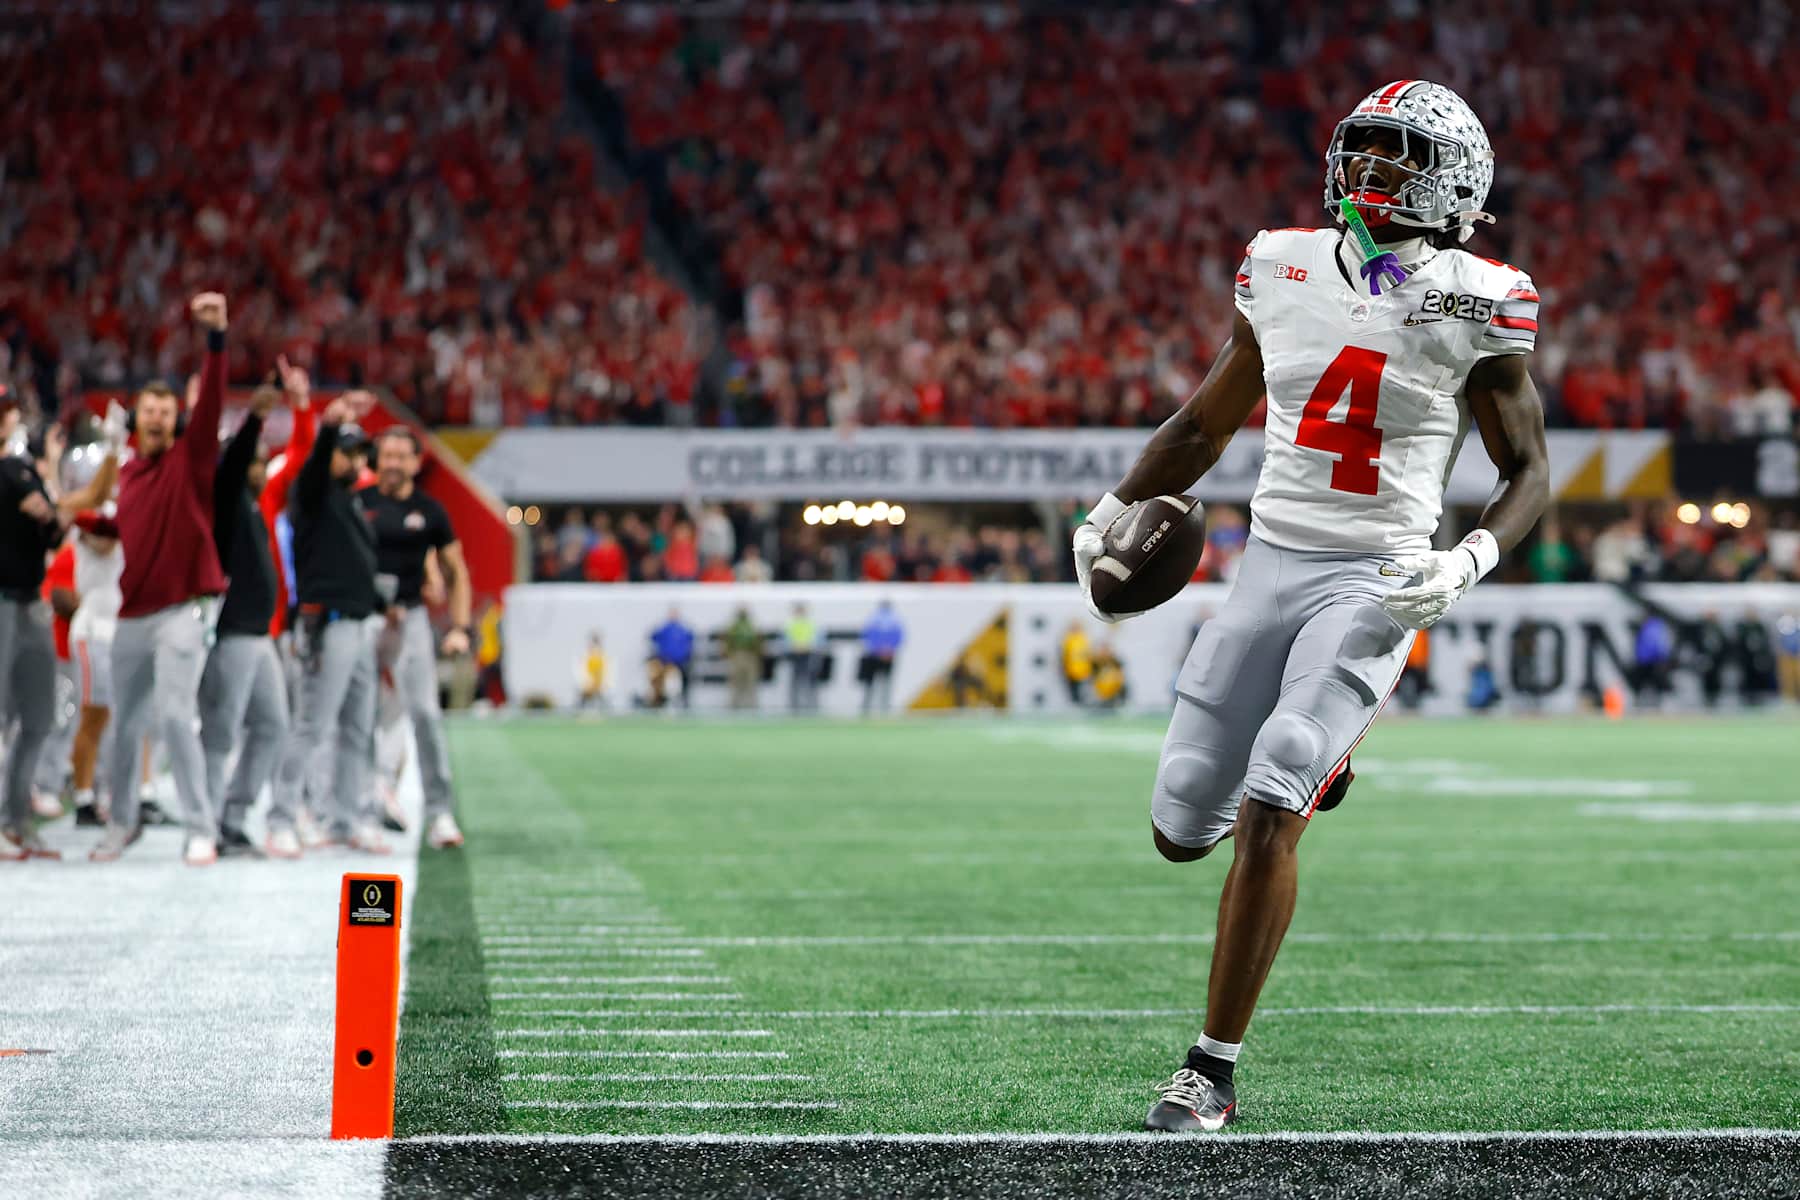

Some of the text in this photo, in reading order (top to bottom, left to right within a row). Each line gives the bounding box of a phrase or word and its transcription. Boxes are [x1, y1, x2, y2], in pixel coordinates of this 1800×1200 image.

[1422, 289, 1494, 323] 2025
[1295, 345, 1387, 496] 4
[687, 446, 1128, 485] COLLEGE FOOTBAL
